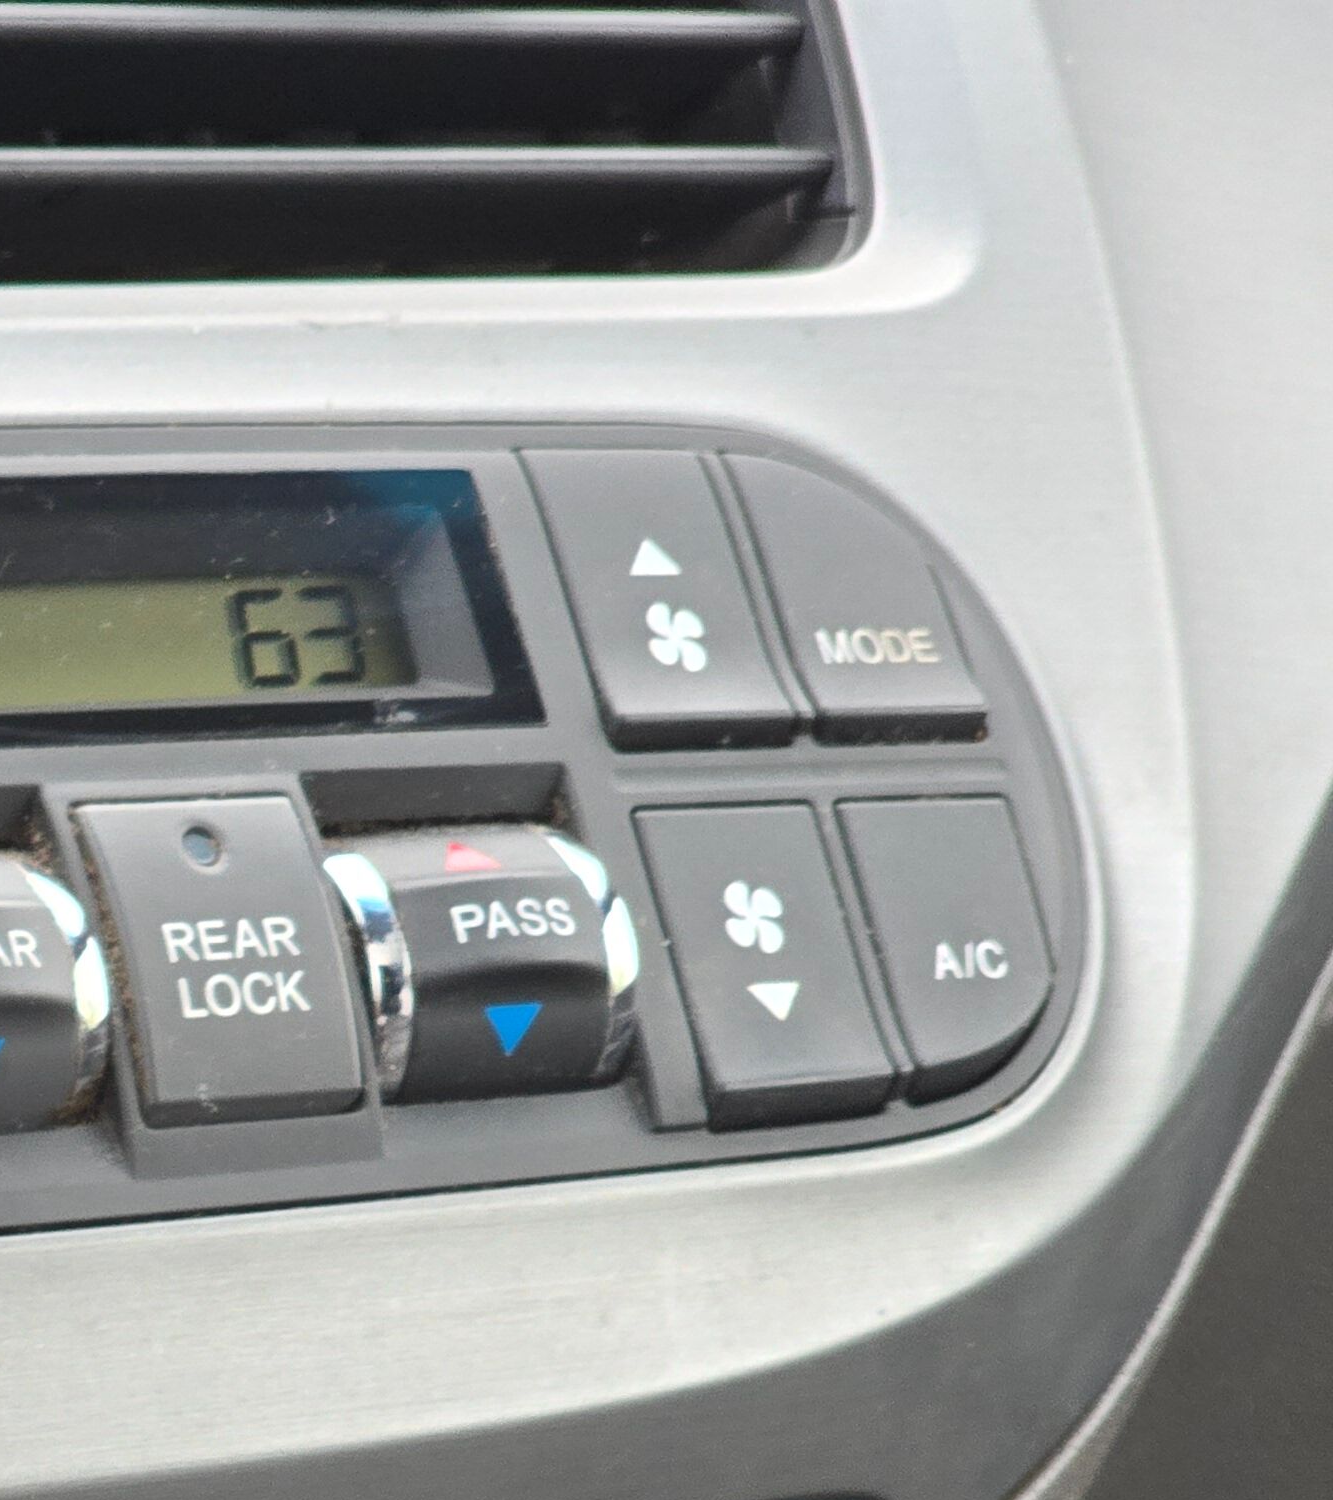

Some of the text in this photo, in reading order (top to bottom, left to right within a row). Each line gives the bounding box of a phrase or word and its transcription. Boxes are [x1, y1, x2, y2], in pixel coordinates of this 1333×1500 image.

[227, 585, 367, 690] 63
[815, 628, 939, 665] MODE
[160, 915, 302, 964] REAR
[449, 896, 577, 945] PASS
[934, 939, 1009, 981] A/C
[177, 969, 312, 1020] LOCK
